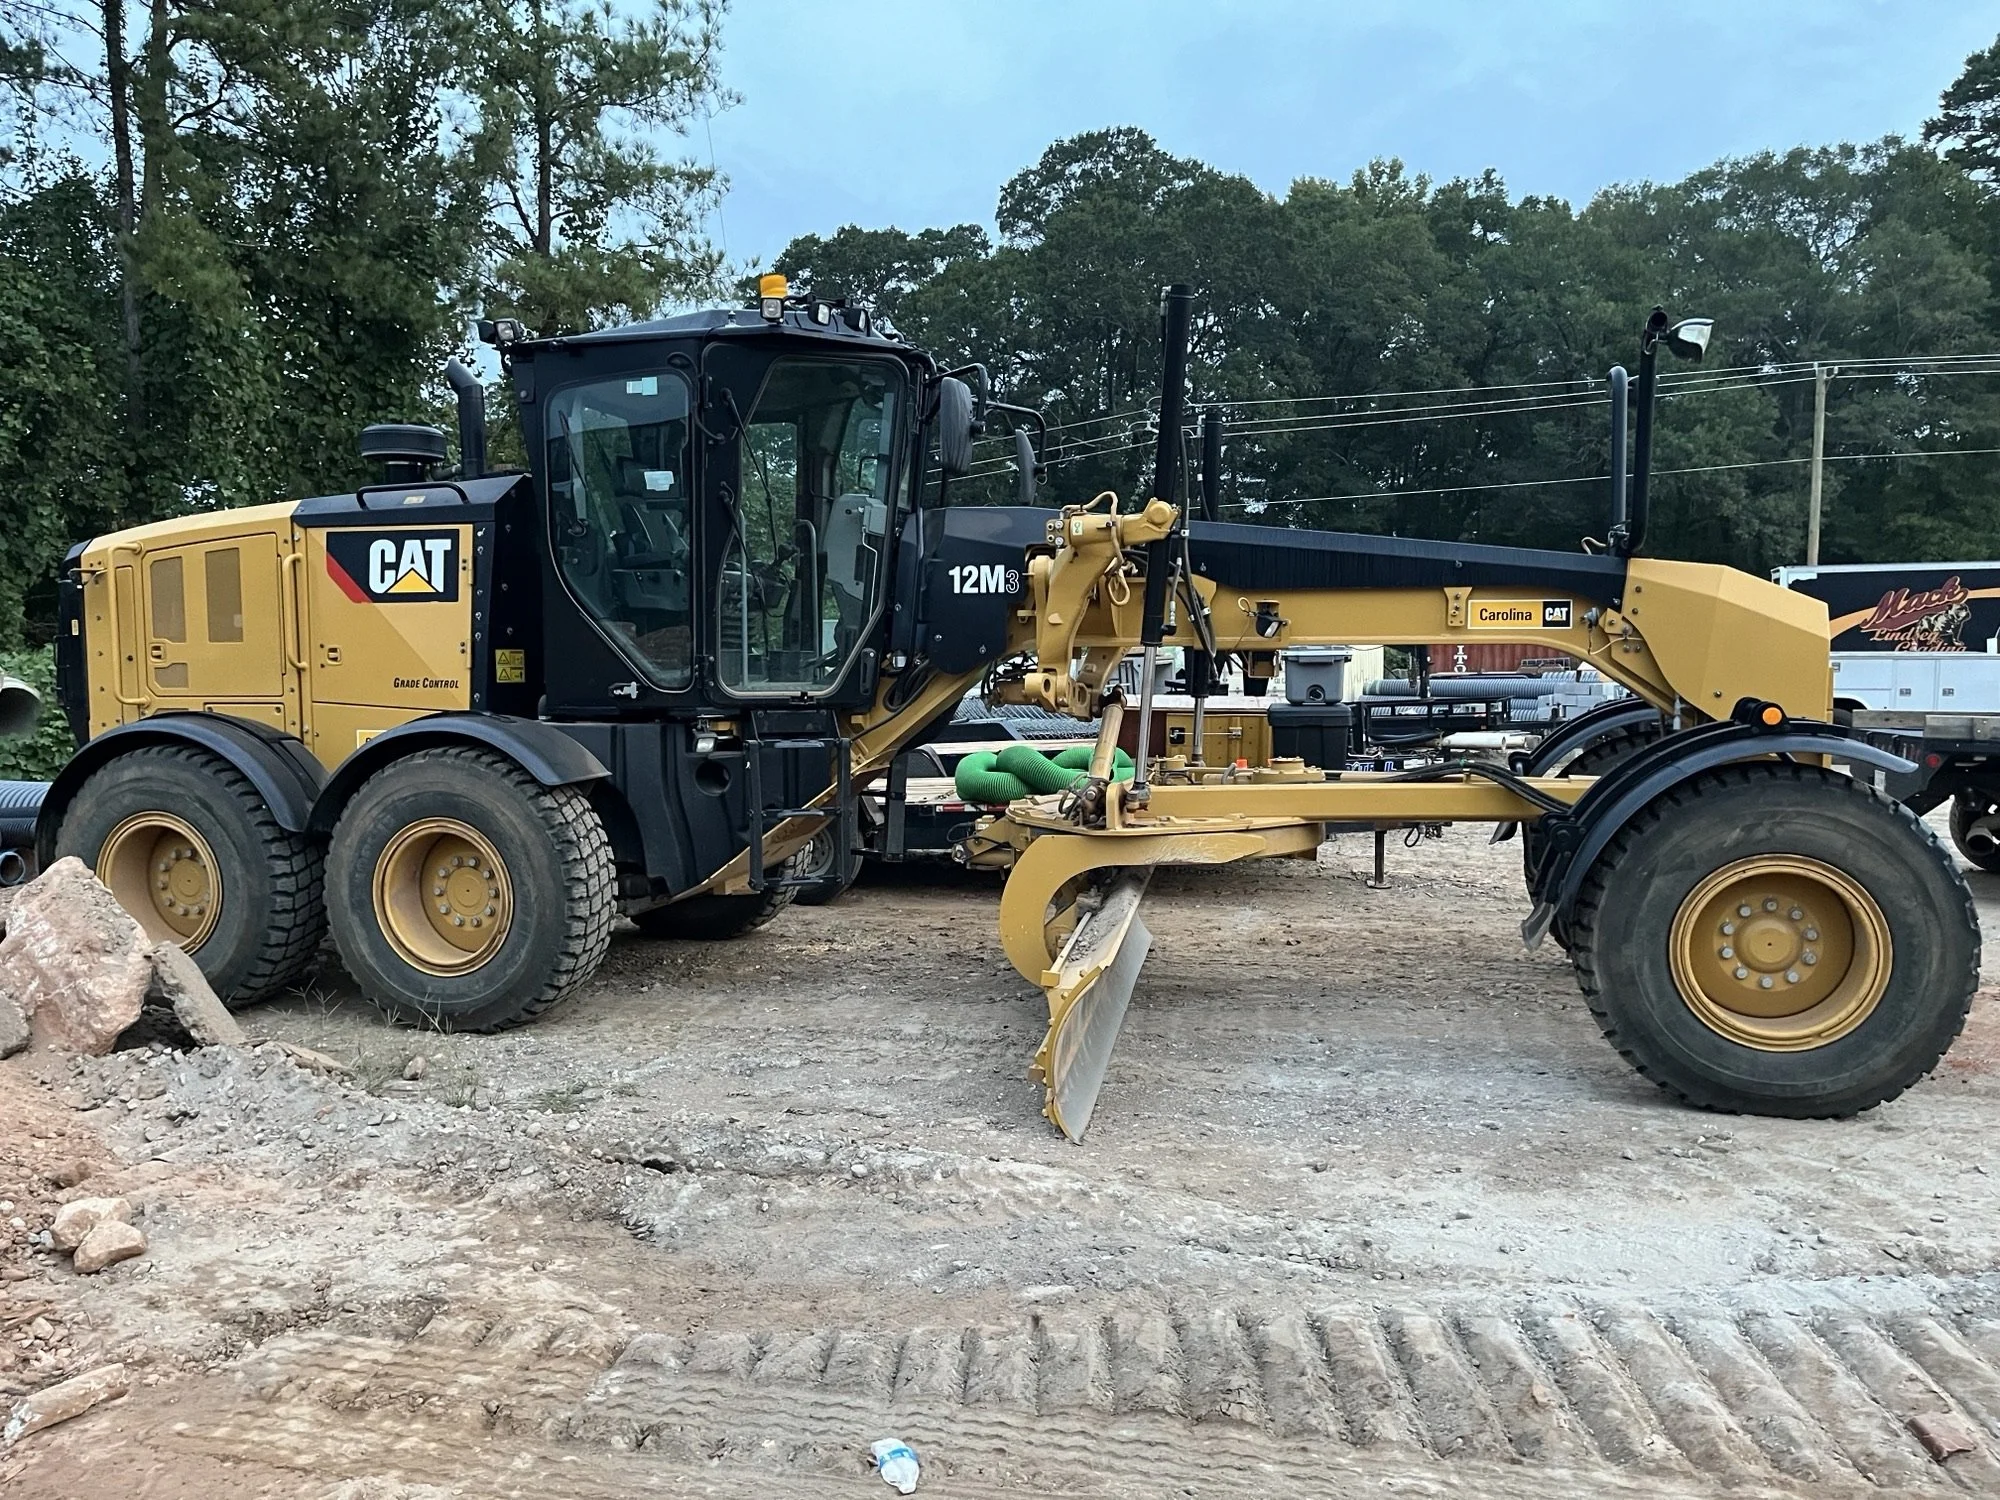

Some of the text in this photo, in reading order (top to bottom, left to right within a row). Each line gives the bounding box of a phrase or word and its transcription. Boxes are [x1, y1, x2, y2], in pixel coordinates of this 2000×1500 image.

[369, 539, 451, 593] CAT
[948, 564, 1020, 594] 12M3
[1479, 607, 1568, 621] Carolina CAT
[1860, 576, 1969, 632] Mack
